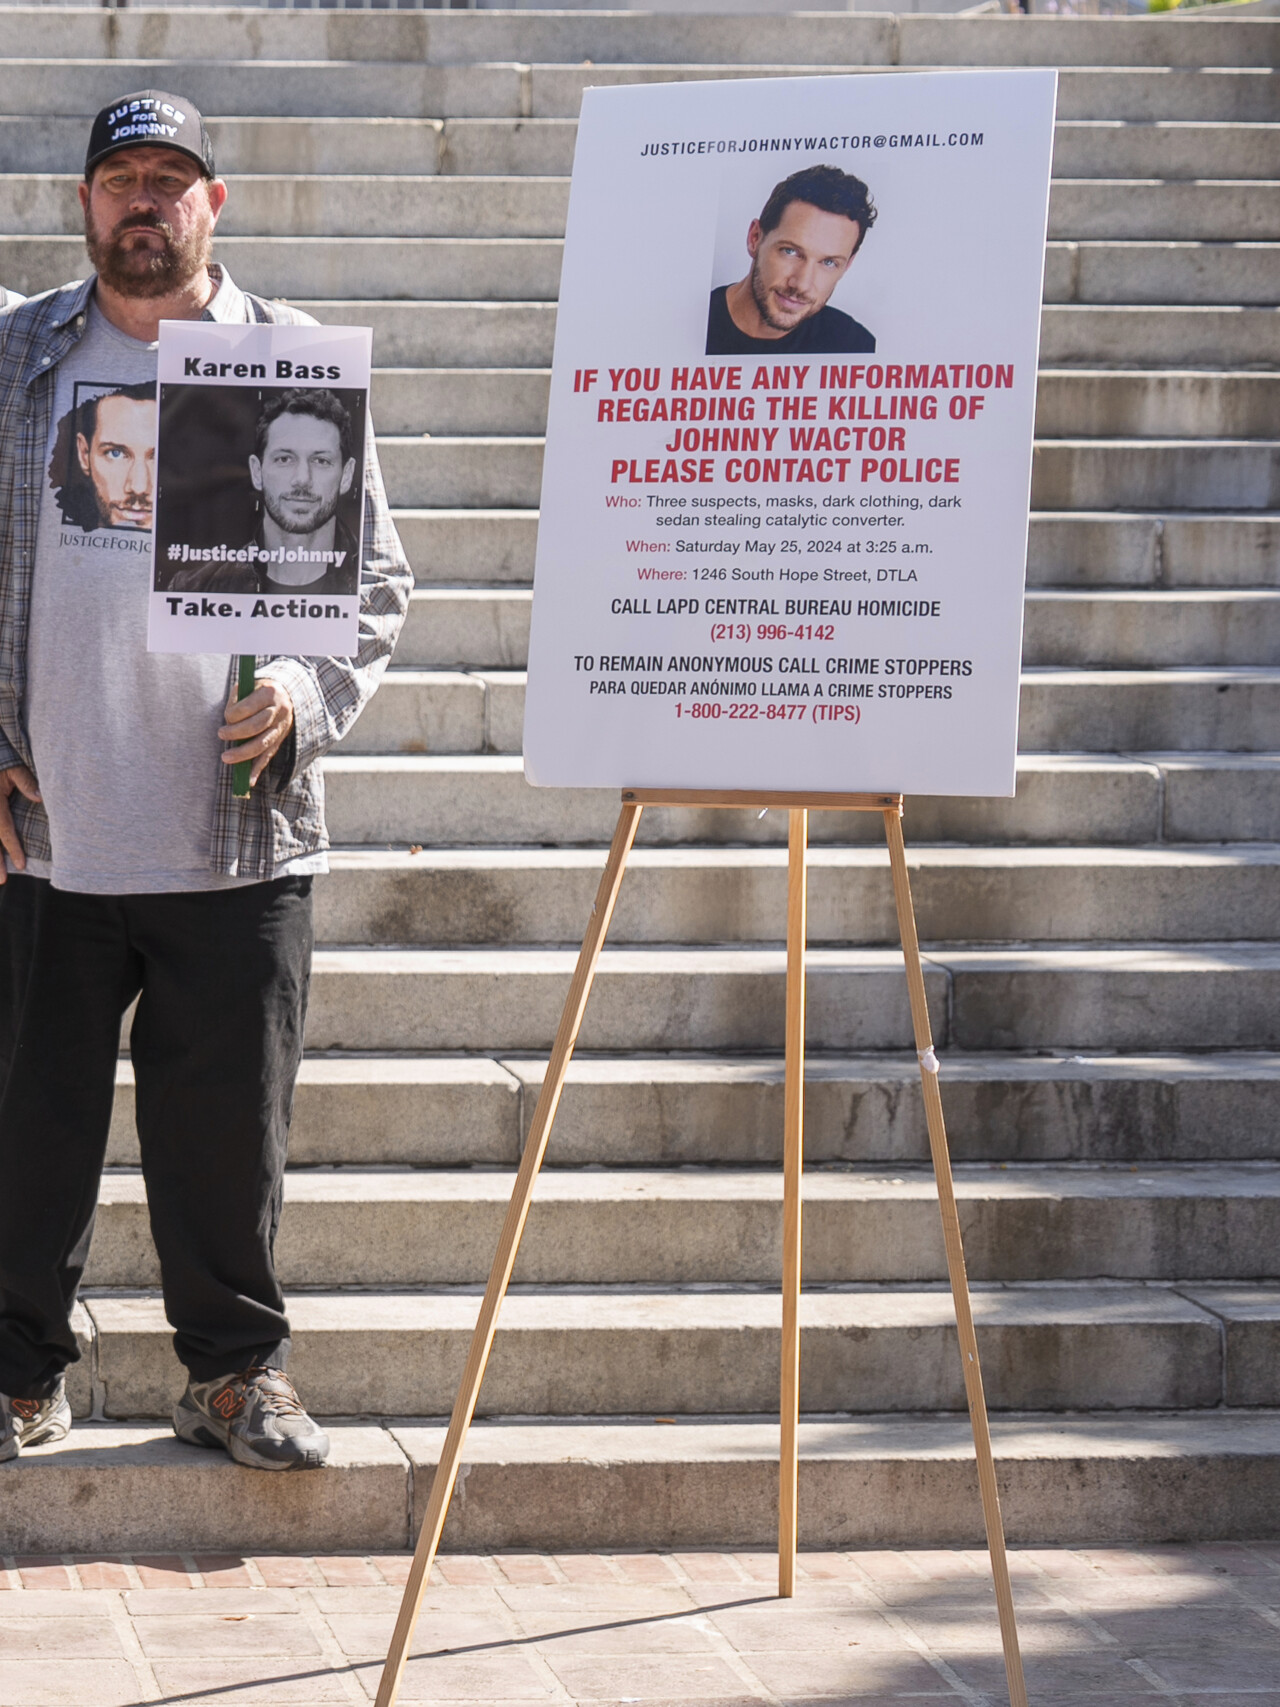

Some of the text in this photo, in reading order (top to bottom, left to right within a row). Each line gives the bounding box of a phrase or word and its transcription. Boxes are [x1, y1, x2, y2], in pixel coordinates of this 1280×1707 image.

[107, 99, 186, 125] JUSTICE
[132, 112, 157, 122] FOR
[111, 123, 177, 140] JOHNNY
[641, 133, 983, 156] JUSTICEFORJOHNNYWACTOR@GMAIL.COM
[184, 357, 341, 380] Karen Bass
[574, 364, 1014, 392] IF YOU HAVE ANY INFORMATION
[598, 395, 984, 422] REGARDING THE KILLING OF
[666, 427, 906, 452] JOHNNY WACTOR
[611, 458, 960, 483] PLEASE CONTACT POLICE
[606, 495, 961, 510] Who: Three suspects, masks, dark clothing, dark
[656, 514, 904, 529] sedan stealing catalytic converter.
[167, 544, 347, 568] #JusticeForJohnny
[626, 540, 932, 555] When: Saturday May 25, 2024 at 3:25 a.m.
[638, 568, 917, 583] Where: 1246 South Hope Street, DTLA
[166, 597, 349, 620] Take. Action.
[612, 599, 941, 616] CALL LAPD CENTRAL BUREAU HOMICIDE
[711, 624, 834, 643] (213) 996-4142
[574, 656, 972, 676] TO REMAIN ANONYMOUS CALL CRIME STOPPERS
[590, 678, 952, 699] PARA QUEDAR ANÓNIMO LLAMA A CRIME STOPPERS
[675, 703, 860, 724] 1-800-222-8477 (TIPS)
